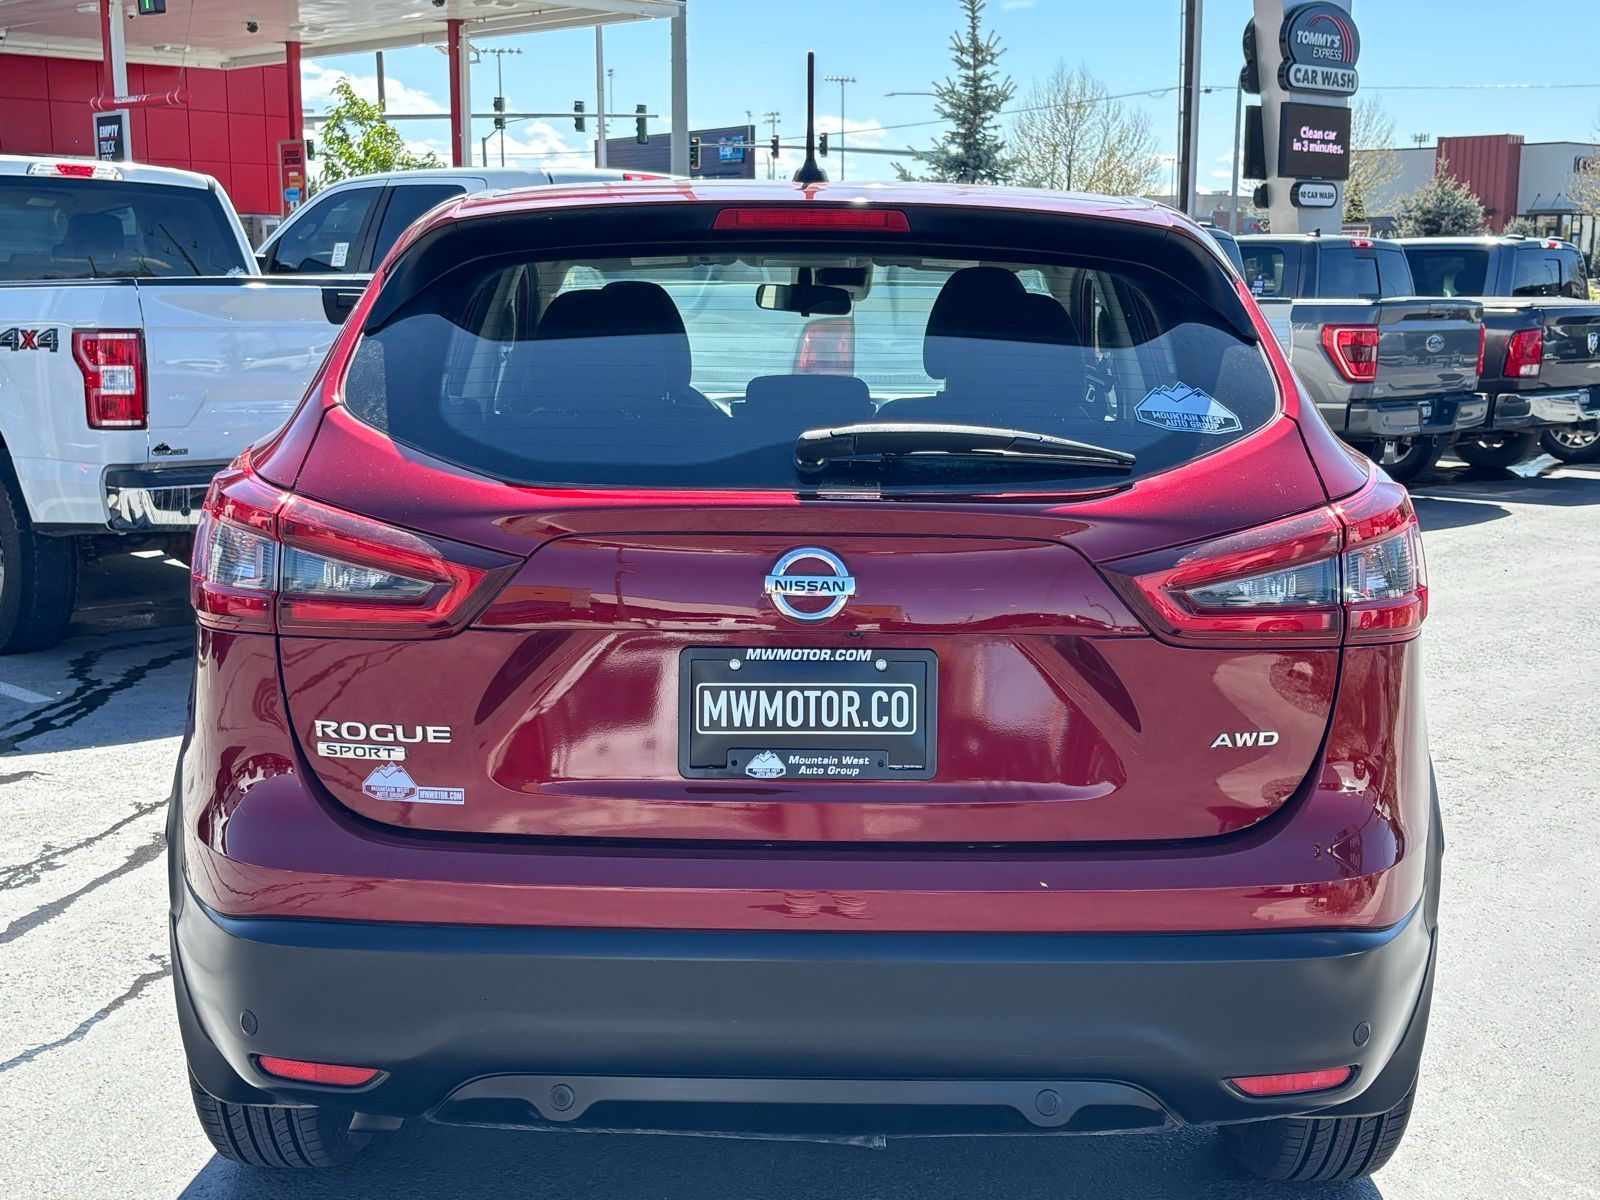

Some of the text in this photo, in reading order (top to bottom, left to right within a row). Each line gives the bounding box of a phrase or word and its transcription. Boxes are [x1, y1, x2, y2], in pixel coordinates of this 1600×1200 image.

[1297, 30, 1341, 48] TOMMY'S
[1313, 47, 1342, 60] EXPRESS
[1294, 68, 1355, 88] CAR WASH
[99, 125, 119, 138] EMPTY
[1300, 126, 1337, 140] Clean car
[1293, 138, 1344, 154] in 3 minutes.
[1307, 191, 1318, 199] CAR
[1319, 191, 1335, 200] WASH
[1152, 411, 1225, 425] MOUNTAIN WEST
[1166, 418, 1219, 431] AUTO GROUP
[774, 580, 845, 592] NISSAN
[745, 648, 872, 662] MWMOTOR.COM
[703, 690, 909, 728] MWMOTOR.CO
[314, 720, 452, 743] ROGUE
[1210, 731, 1279, 749] AWD
[326, 744, 396, 759] SPORT
[788, 755, 870, 765] Mountain West
[798, 765, 860, 777] Auto Group
